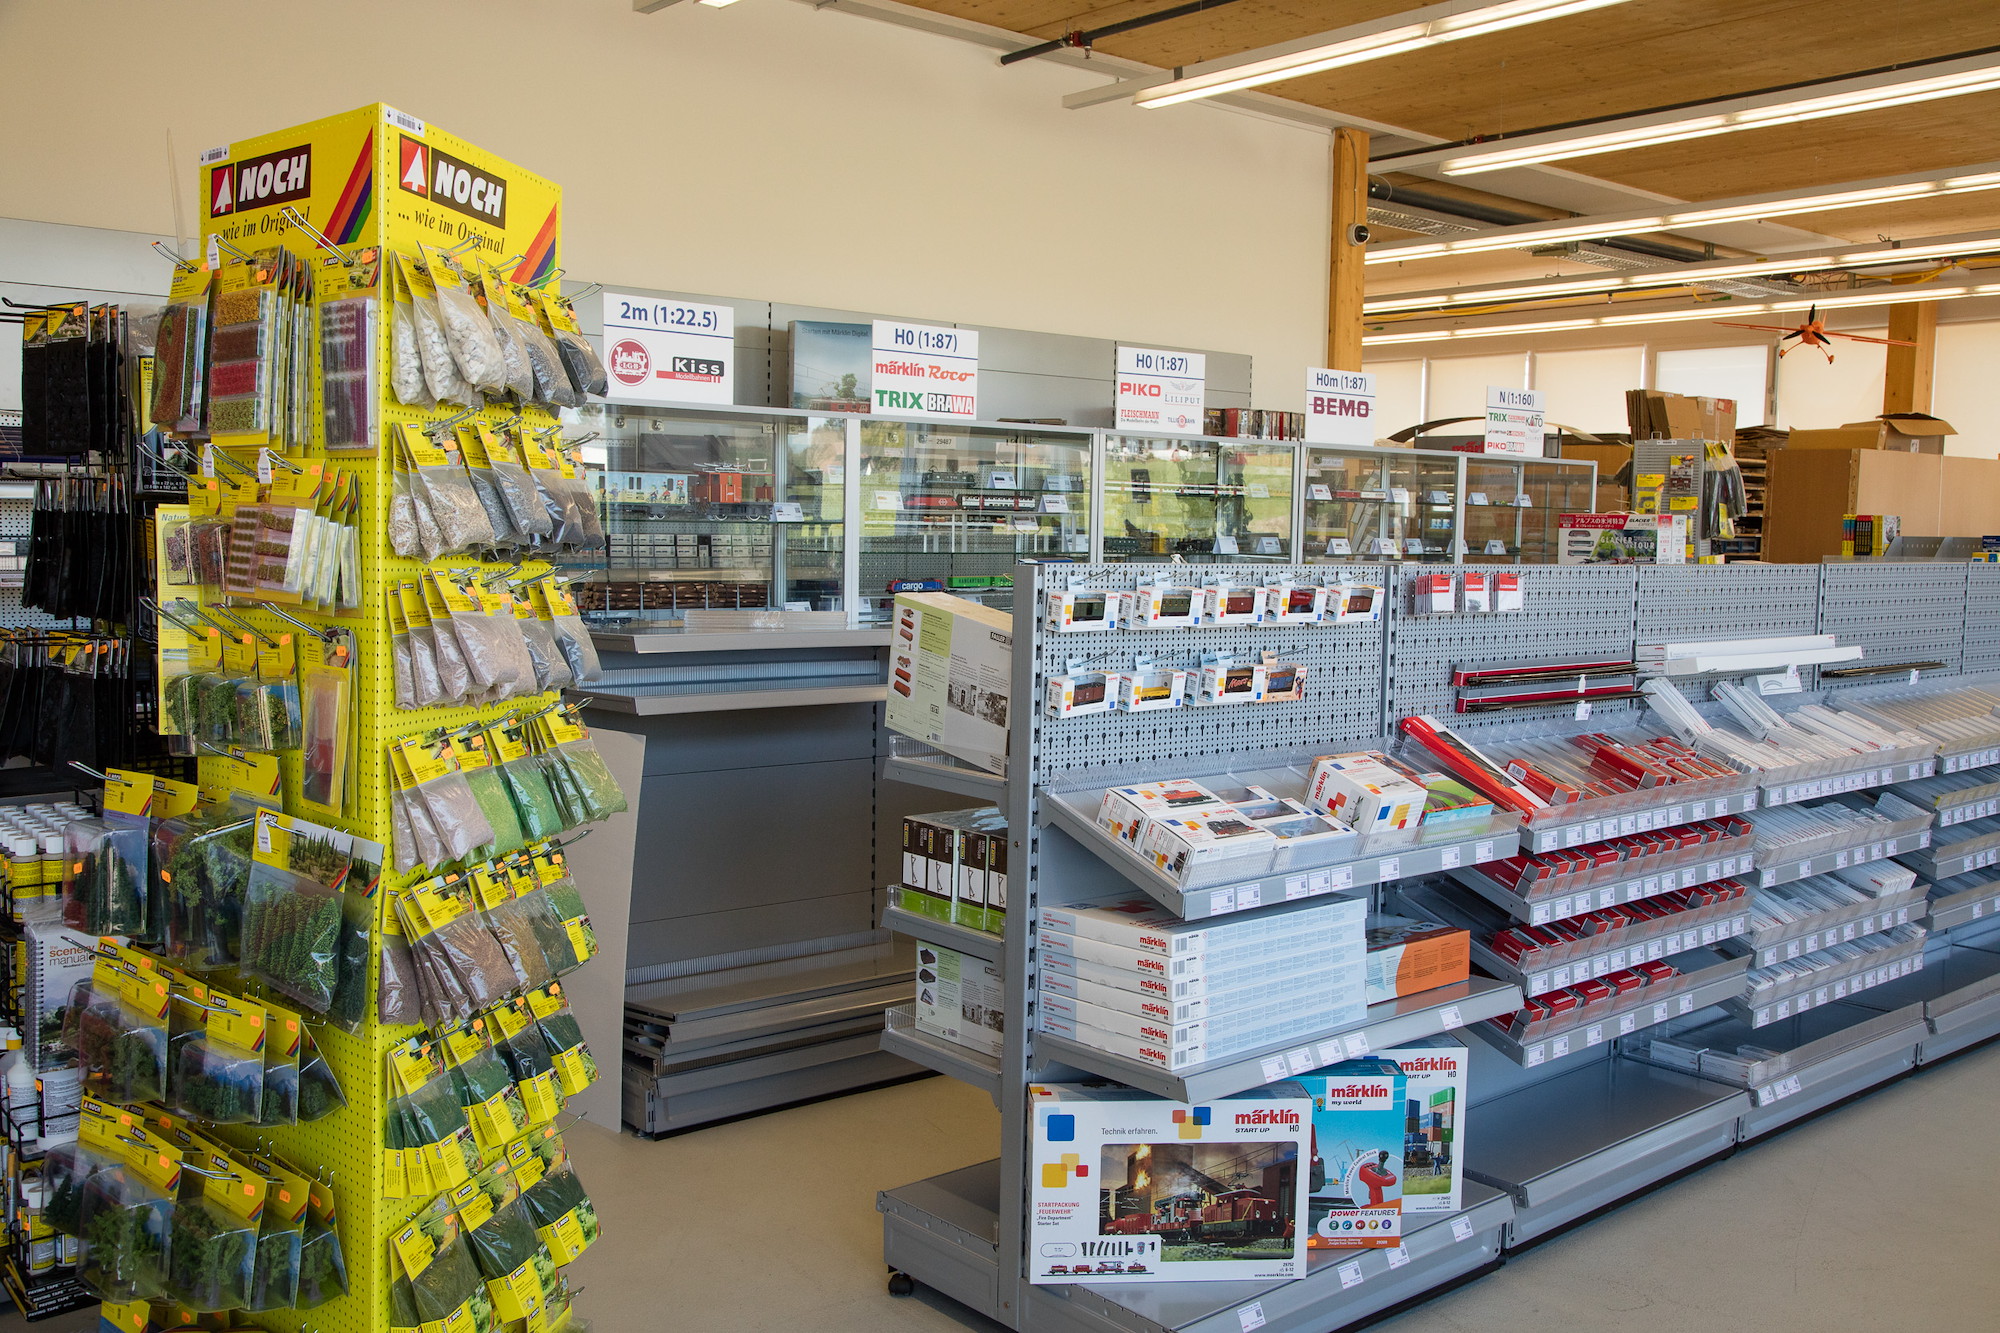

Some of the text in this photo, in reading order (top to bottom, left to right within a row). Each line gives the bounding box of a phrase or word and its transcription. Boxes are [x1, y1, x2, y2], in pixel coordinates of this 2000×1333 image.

[239, 154, 308, 202] NOCH
[435, 160, 503, 218] NOCH
[223, 206, 311, 240] wie im Original
[415, 209, 436, 230] wie
[439, 215, 453, 236] im
[457, 222, 505, 255] Original
[621, 302, 718, 331] 2m (1:22.5)
[919, 330, 957, 352] (1:87)
[675, 358, 720, 375] Kiss
[1155, 355, 1188, 374] (1:87)
[675, 373, 711, 382] Modellbahnen
[928, 365, 974, 382] Roco
[1120, 382, 1161, 397] PIKO
[1341, 374, 1367, 392] (1:87)
[875, 390, 974, 414] TRIX BRAWA
[1164, 394, 1200, 404] LILIPUT
[1499, 391, 1535, 407] N (1:160)
[1121, 409, 1159, 419] FLEISCHMANN
[1313, 396, 1370, 418] BEMO
[1489, 413, 1508, 422] TRIX
[1487, 442, 1507, 450] PIKO
[1600, 535, 1633, 544] GLACIER
[1634, 541, 1655, 549] TOUR
[901, 581, 924, 591] cargo
[49, 953, 89, 966] manual
[1331, 1084, 1388, 1098] märklin
[1235, 1109, 1299, 1124] märklin
[1128, 1127, 1158, 1135] erfahren.
[1330, 1209, 1360, 1218] power
[28, 1286, 45, 1295] PAVING
[33, 1294, 51, 1302] PAVING
[39, 1299, 56, 1308] PAVING
[28, 1309, 46, 1317] PAVING
